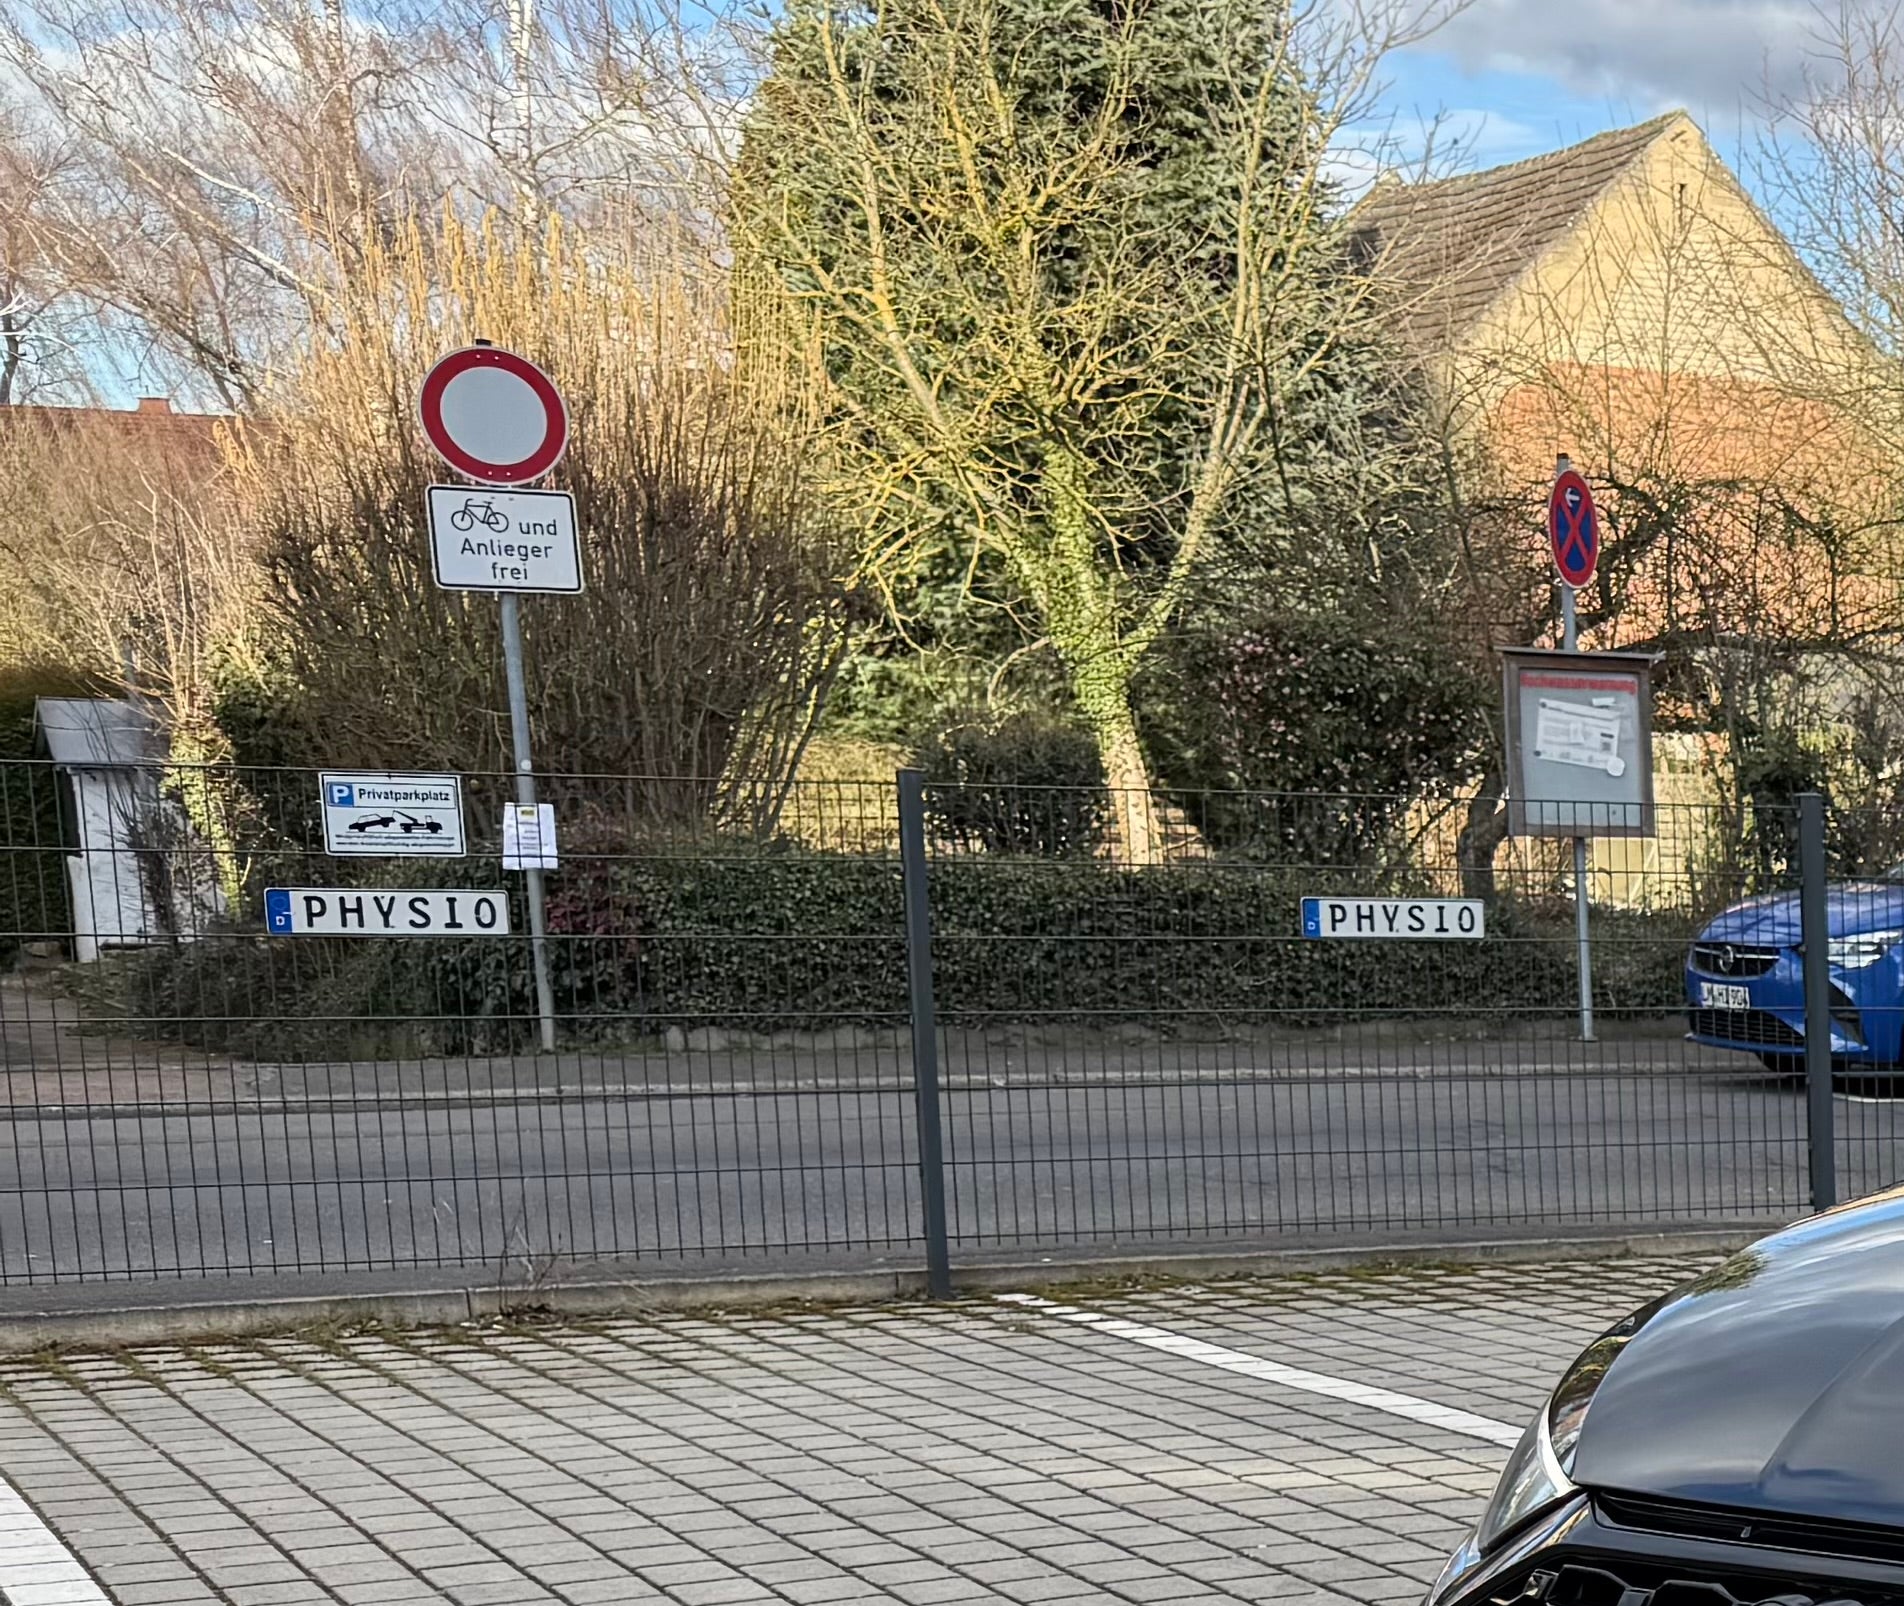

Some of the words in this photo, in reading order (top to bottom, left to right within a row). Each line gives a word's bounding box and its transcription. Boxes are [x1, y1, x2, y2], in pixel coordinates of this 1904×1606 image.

[519, 519, 557, 536] und
[460, 537, 553, 561] Anlieger
[491, 562, 528, 580] frei
[358, 788, 450, 803] Privatparkplatz
[303, 896, 497, 929] PHYSIO
[1328, 904, 1475, 933] PHYSIO
